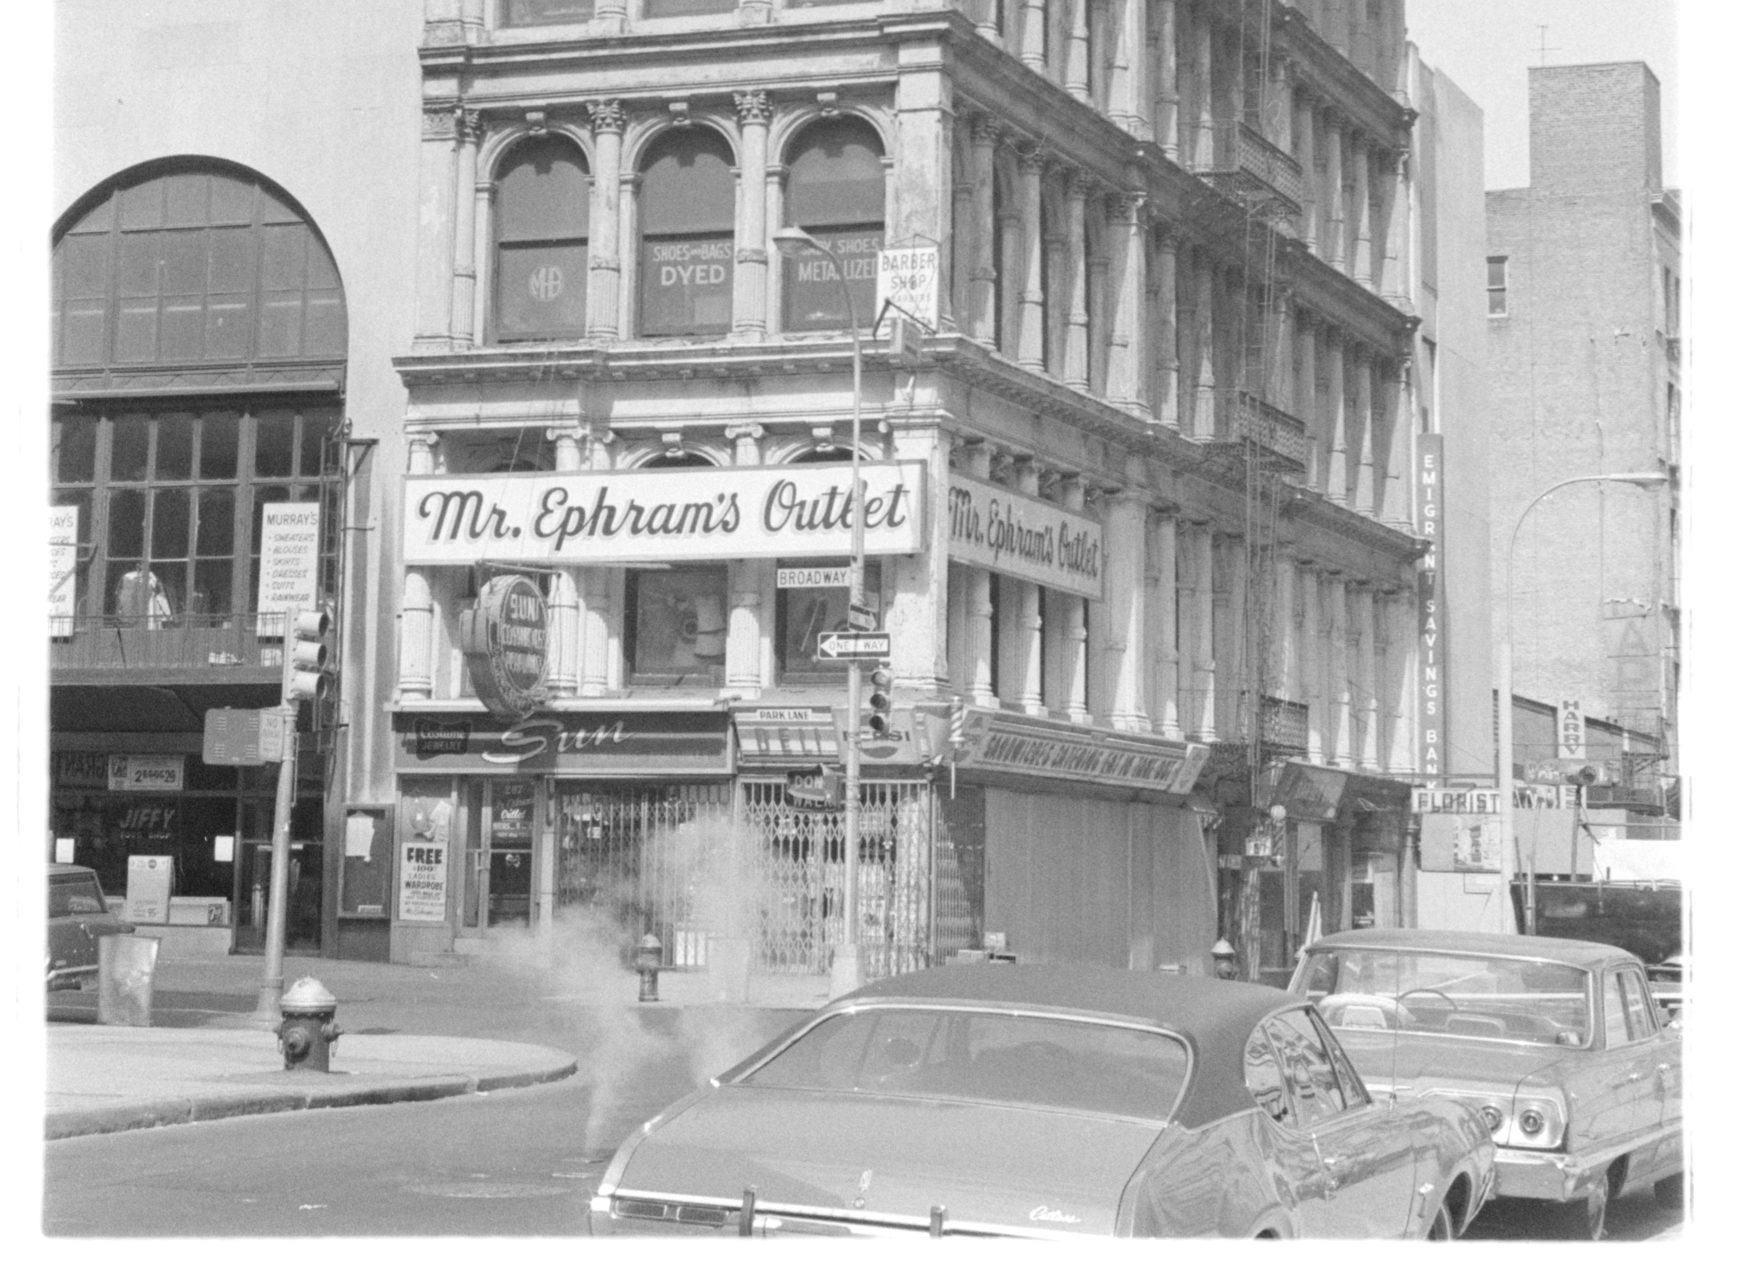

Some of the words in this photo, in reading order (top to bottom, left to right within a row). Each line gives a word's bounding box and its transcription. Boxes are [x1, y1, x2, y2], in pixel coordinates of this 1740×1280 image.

[653, 245, 690, 262] SHOES
[701, 242, 732, 261] BAGS
[837, 237, 879, 254] SHOES
[882, 252, 936, 272] BARBER
[660, 264, 725, 286] DYED
[890, 274, 927, 290] SHOP
[266, 511, 319, 526] MURRAY'S
[418, 486, 522, 541] Mr.
[532, 485, 741, 552] Ephram's
[762, 478, 911, 534] Outlet
[948, 485, 984, 543] Mr.
[987, 497, 1054, 565] Ephram's
[1058, 520, 1100, 578] Outlet
[272, 544, 309, 554] BLOUSES
[778, 570, 848, 587] BROADWAY
[828, 641, 850, 652] ONE
[863, 640, 886, 651] WAY
[1424, 599, 1438, 716] SAVINGS
[760, 710, 787, 721] PARK
[787, 710, 810, 721] LANE
[1562, 700, 1581, 756] HARRY
[481, 720, 637, 764] Sun
[754, 727, 822, 755] DELI
[1425, 729, 1438, 790] BANK
[1418, 792, 1500, 814] FLORIST
[120, 808, 176, 829] JIFFY
[406, 846, 443, 865] FREE
[405, 880, 445, 891] WARDROBE
